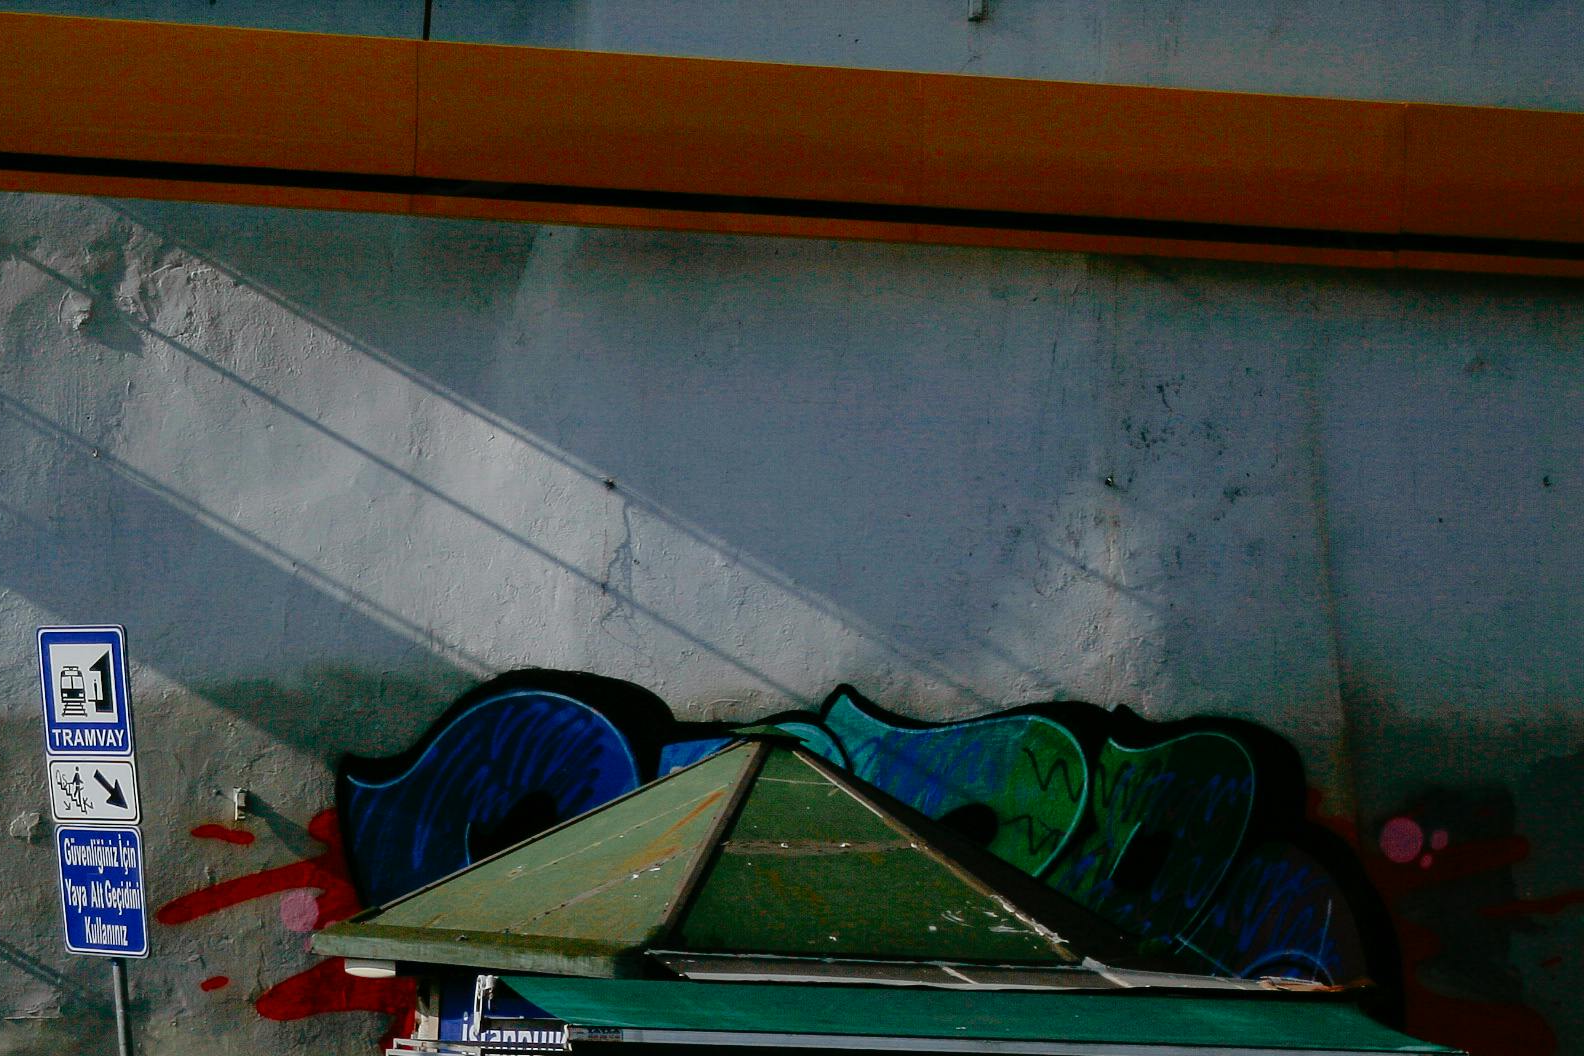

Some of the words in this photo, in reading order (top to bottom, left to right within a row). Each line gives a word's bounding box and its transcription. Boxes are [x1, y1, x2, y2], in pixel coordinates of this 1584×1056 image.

[52, 728, 125, 748] TRAMVAY
[64, 837, 119, 874] Güvenliğiniz
[118, 833, 136, 875] İçin
[65, 878, 87, 913] Yaya
[91, 880, 104, 909] Alt
[105, 879, 141, 915] Geçidini
[84, 916, 128, 946] Kullanınız
